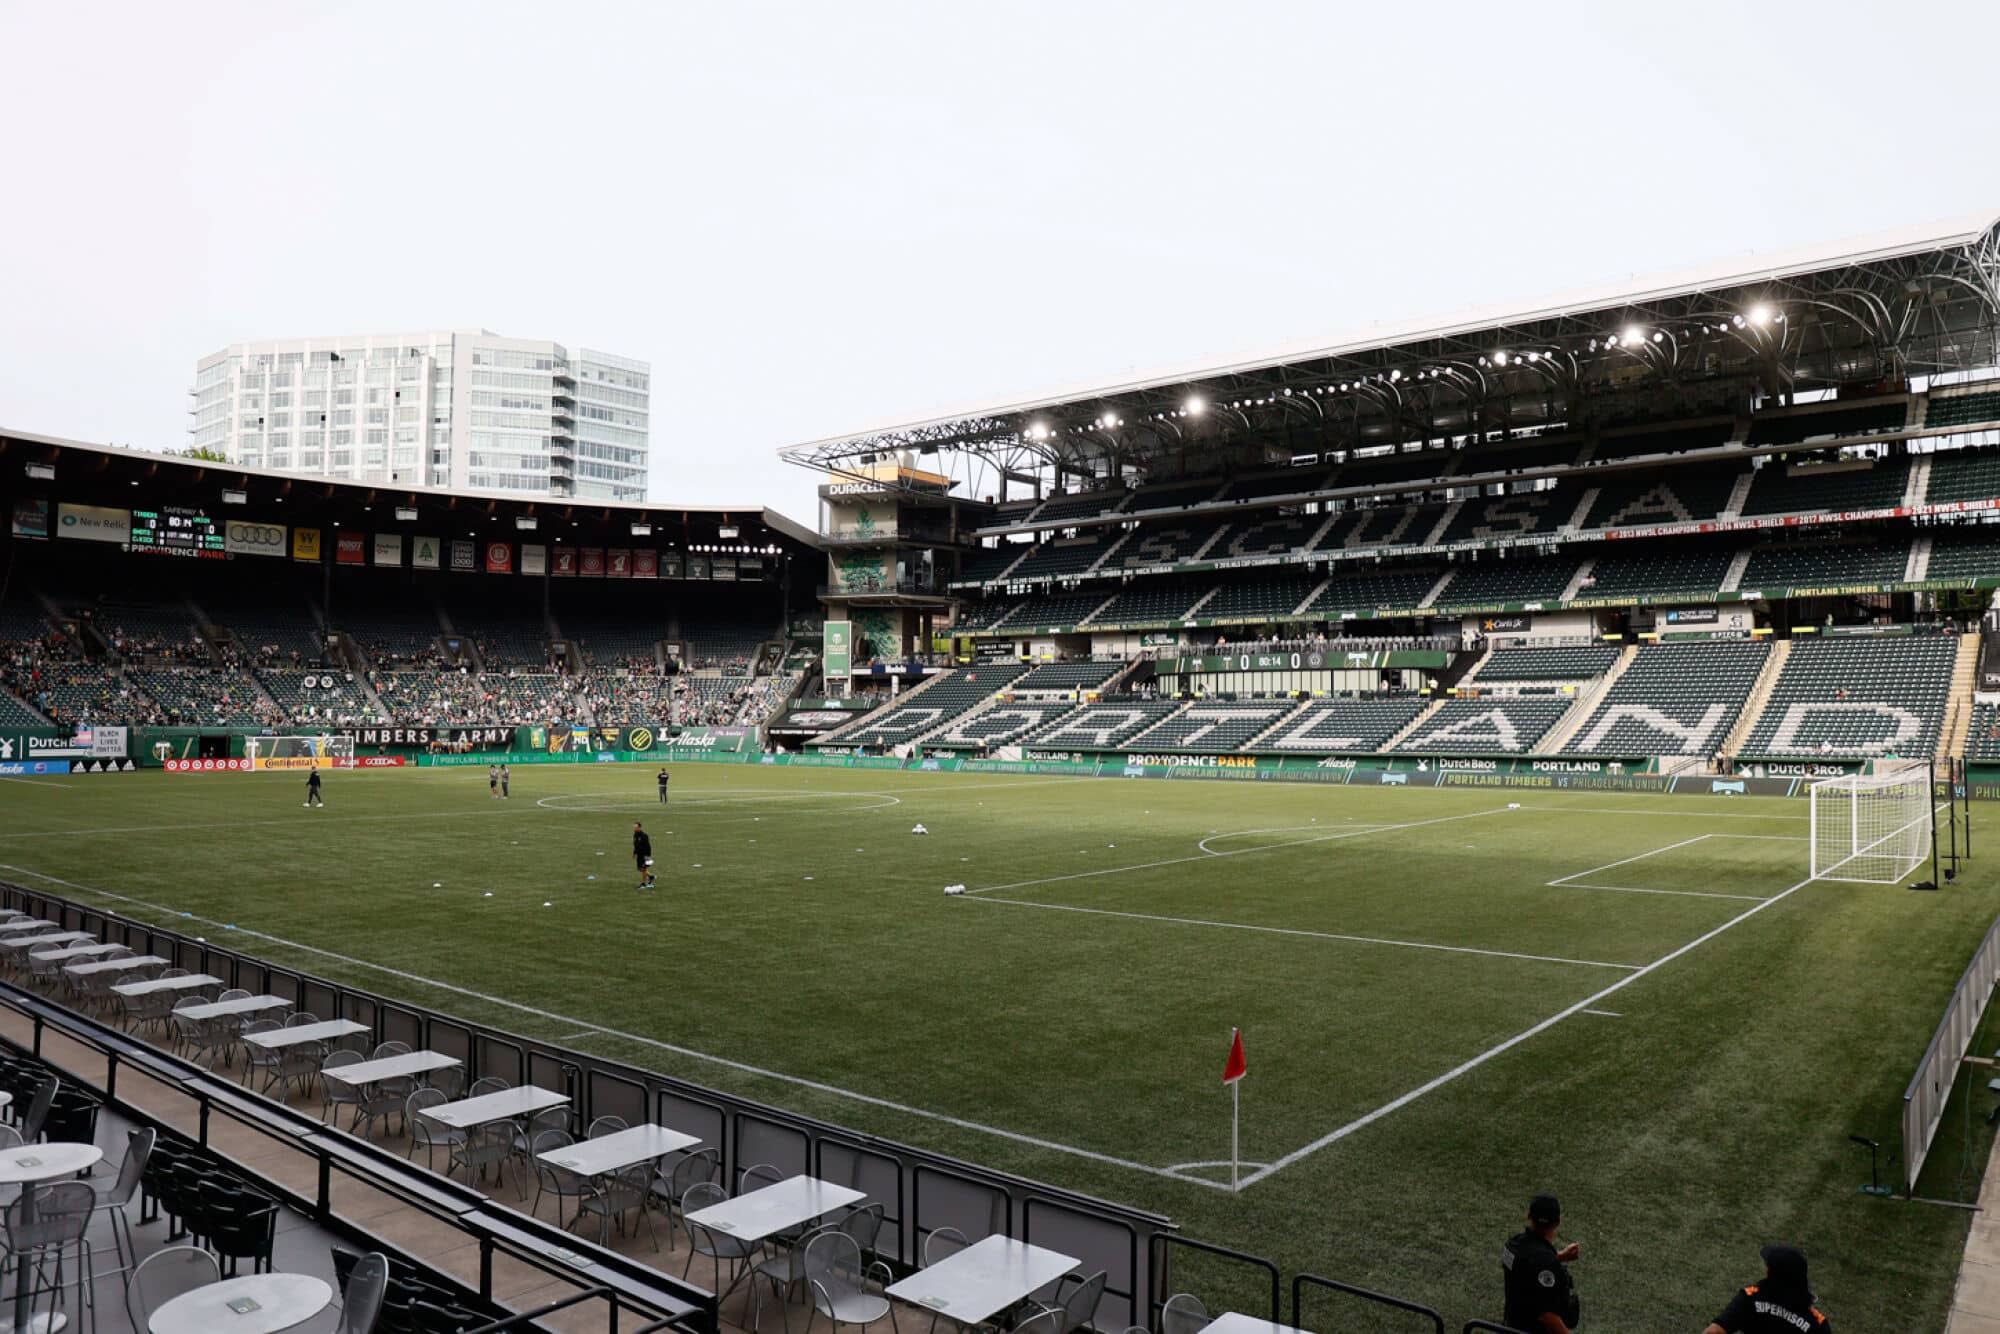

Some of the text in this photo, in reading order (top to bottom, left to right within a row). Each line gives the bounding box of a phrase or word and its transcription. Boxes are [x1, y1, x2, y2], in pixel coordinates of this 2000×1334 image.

[163, 506, 197, 515] SAFEWAY
[1934, 503, 1959, 513] NWSL
[1963, 500, 1995, 511] SHIELD
[1819, 513, 1844, 523] NWSL
[1845, 509, 1895, 520] CHAMPIONS
[80, 517, 126, 529] New Relic
[1734, 520, 1755, 530] NWSL
[1758, 517, 1784, 528] SHIELD
[1658, 525, 1700, 536] CHAMPIONS
[1566, 532, 1605, 543] CHAMPIONS
[1795, 588, 1838, 597] PORTLAND
[1841, 585, 1878, 594] TIMBERS
[1895, 582, 1942, 592] PHILADELPHIA
[1569, 600, 1605, 608] PORTLAND
[1607, 598, 1638, 607] TIMBERS
[1379, 610, 1409, 618] PORTLAND
[1411, 608, 1438, 616] TIMBERS
[1240, 653, 1301, 670] 0 80:14 0
[342, 728, 510, 743] TIMBERS ARMY
[665, 730, 717, 747] Alaska
[29, 737, 67, 748] DUTCH
[1026, 751, 1069, 761] PORTLAND
[265, 758, 313, 769] Continental
[1317, 756, 1357, 769] Alaska
[1440, 759, 1497, 769] DUTCH BROS
[1532, 761, 1600, 772] PORTLAND
[1176, 768, 1217, 777] PORTLAND
[1220, 769, 1256, 778] TIMBERS
[1447, 775, 1663, 790] PORTLAND TIMBERS VS PHILADELPHIA UNION
[1754, 1301, 1811, 1333] SUPERVISOR
